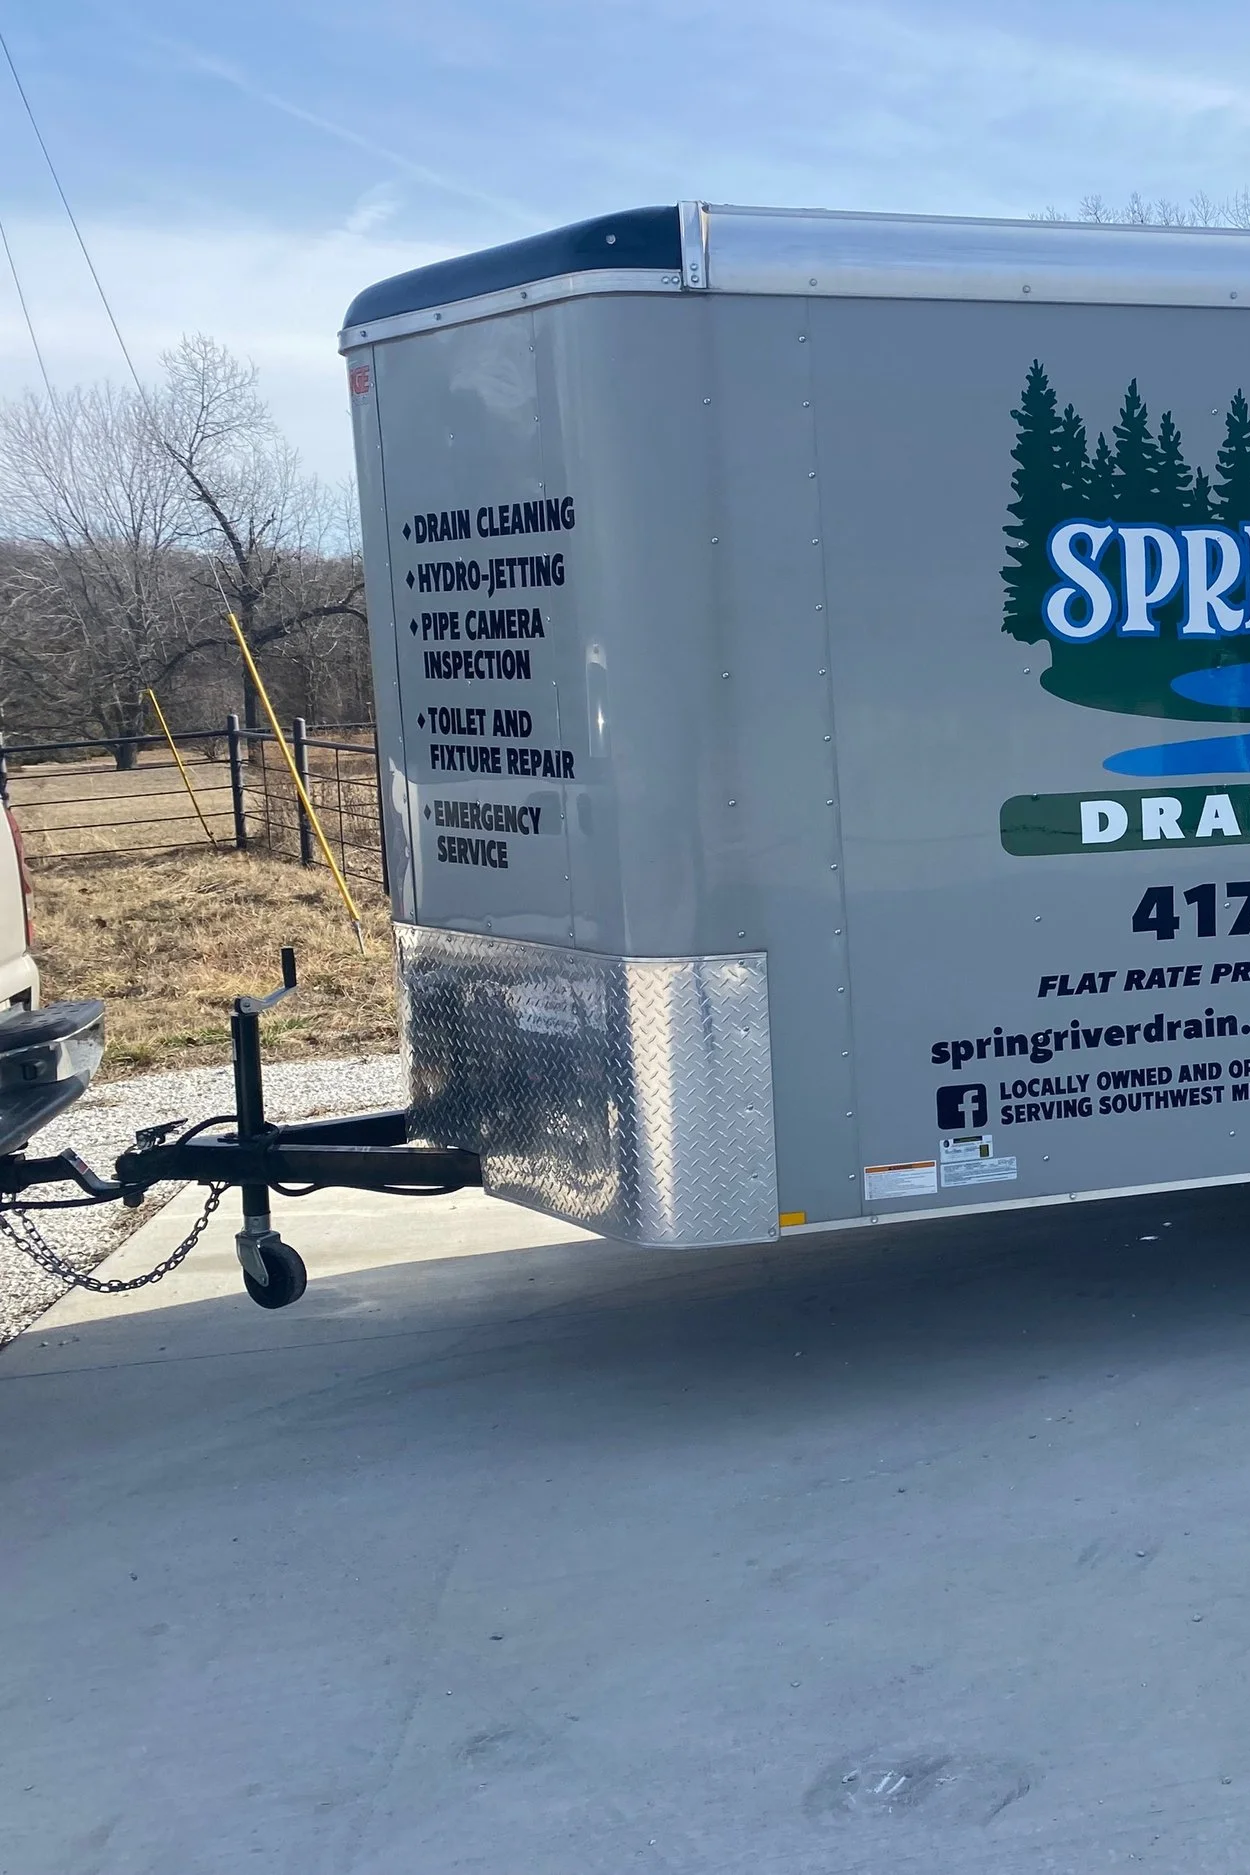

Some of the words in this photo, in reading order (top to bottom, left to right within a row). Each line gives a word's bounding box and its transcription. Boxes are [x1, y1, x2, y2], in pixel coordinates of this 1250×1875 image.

[414, 508, 472, 544] DRAIN
[476, 496, 575, 538] CLEANING
[417, 553, 565, 598] HYDRO-JETTING
[421, 611, 460, 641] PIPE
[465, 608, 545, 641] CAMERA
[423, 649, 531, 680] INSPECTION
[428, 706, 486, 735] TOILET
[492, 709, 533, 738] AND
[430, 744, 501, 774] FIXTURE
[506, 748, 575, 779] REPAIR
[433, 800, 542, 835] EMERGENCY
[437, 835, 509, 869] SERVICE
[1037, 971, 1117, 998] FLAT
[1123, 964, 1203, 992] RATE
[1000, 1074, 1090, 1100] LOCALLY
[1097, 1066, 1173, 1091] OWNED
[1178, 1062, 1222, 1084] AND
[1001, 1097, 1093, 1126] SERVING
[1099, 1085, 1224, 1115] SOUTHWEST
